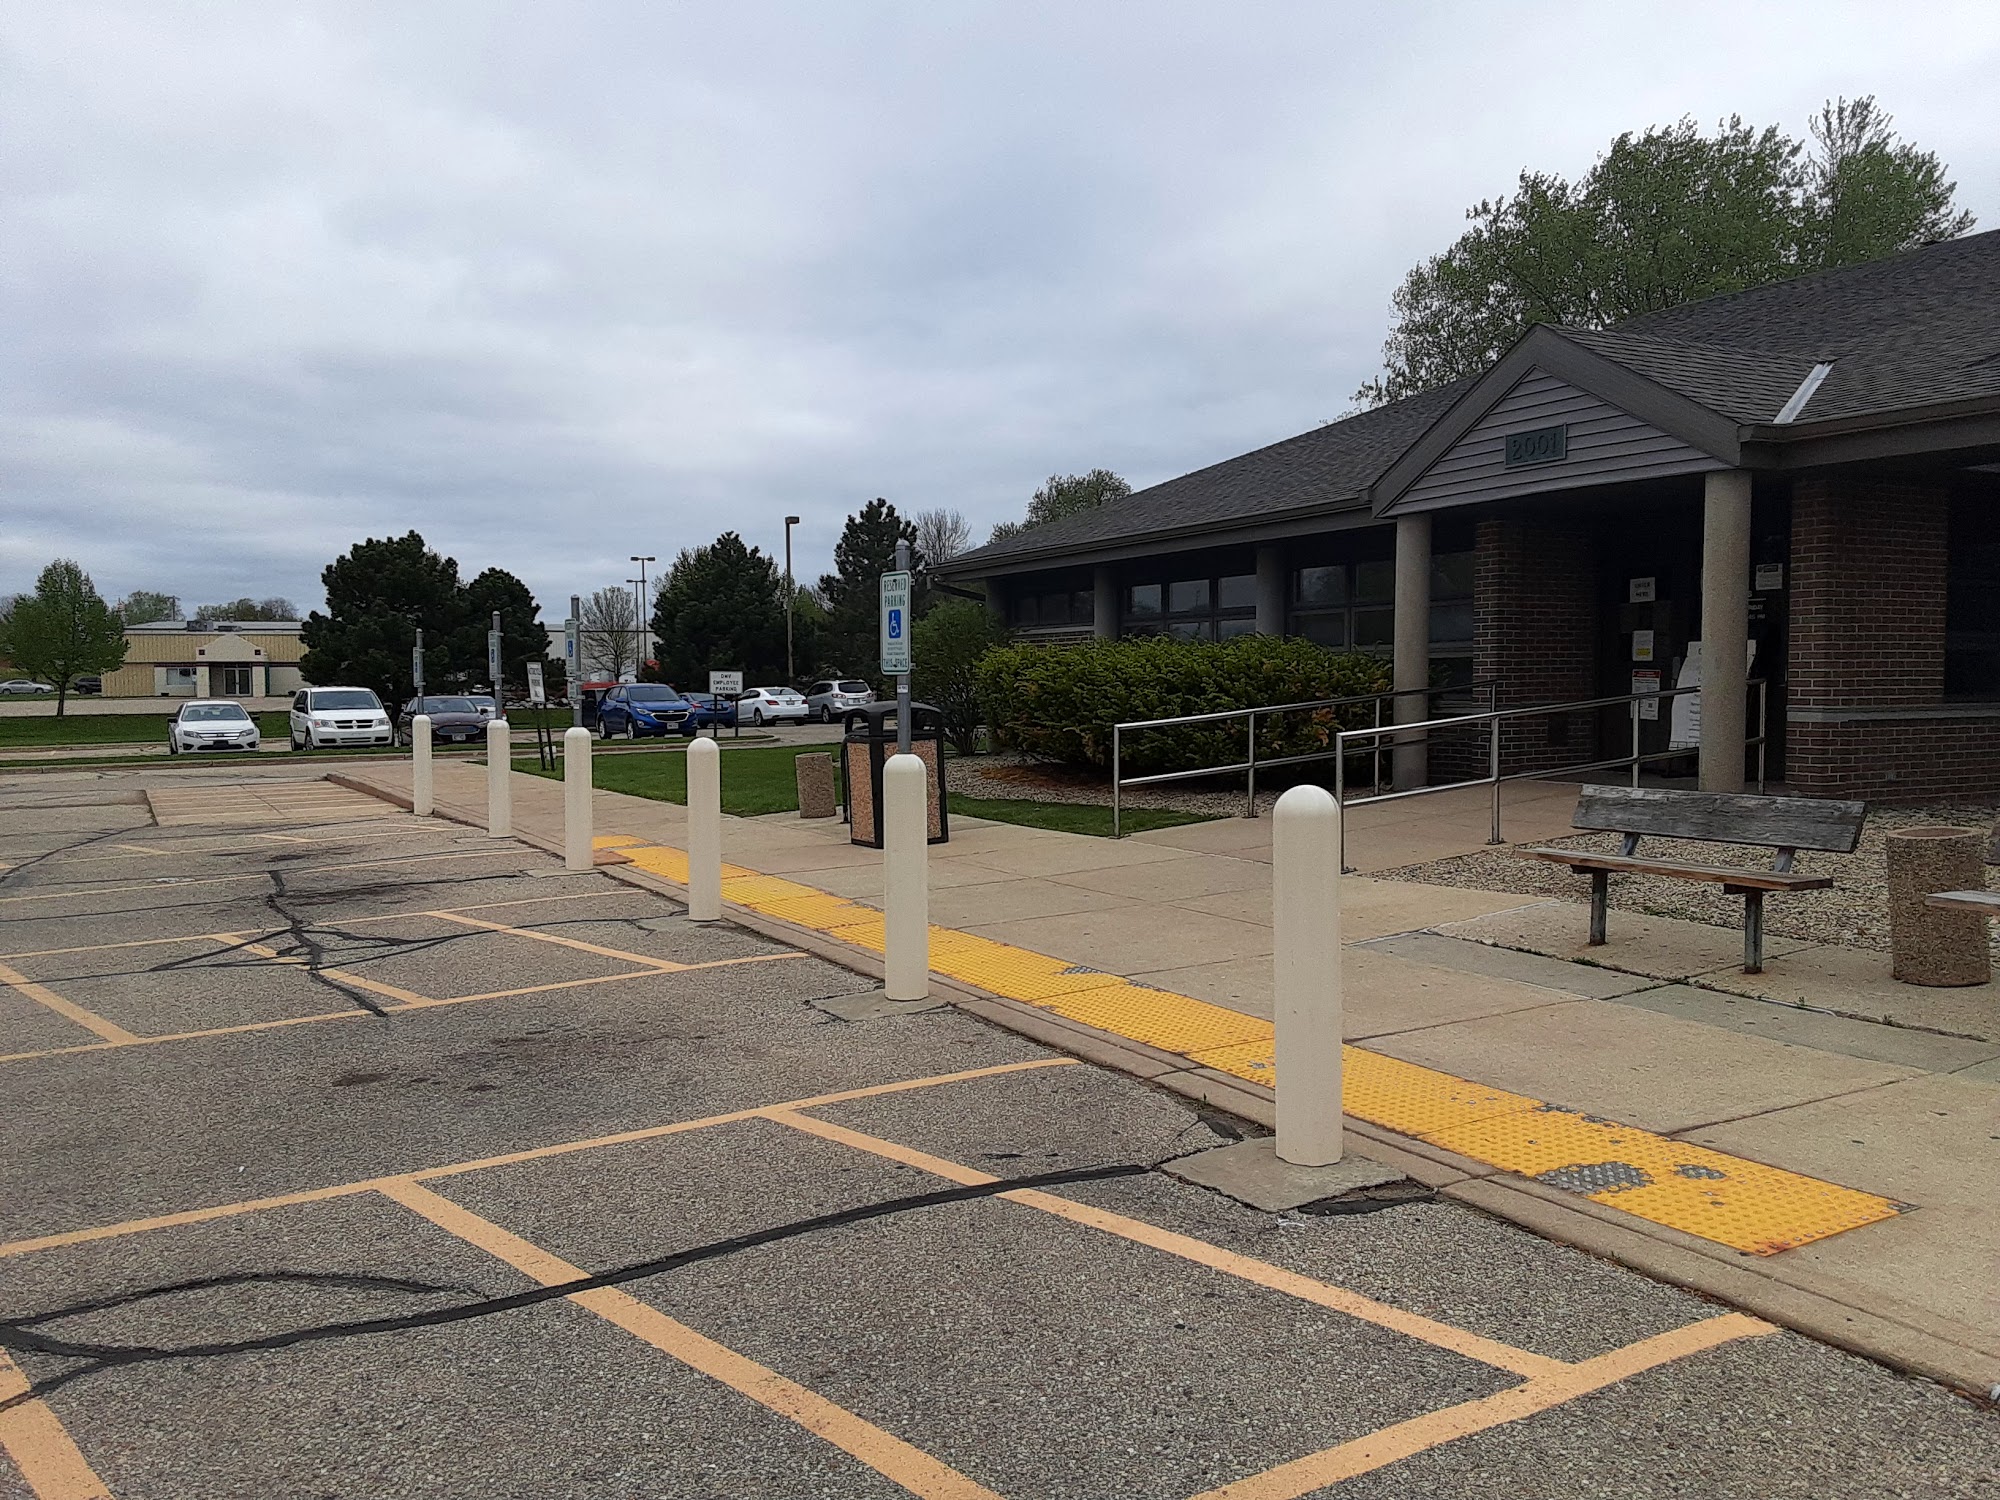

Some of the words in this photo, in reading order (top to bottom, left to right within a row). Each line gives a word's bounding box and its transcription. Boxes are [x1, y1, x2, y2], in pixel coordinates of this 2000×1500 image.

[1512, 433, 1557, 460] 2001
[884, 578, 906, 592] RESERVED
[885, 594, 906, 608] PARKING
[883, 658, 893, 668] THIS
[894, 657, 908, 668] SPACE
